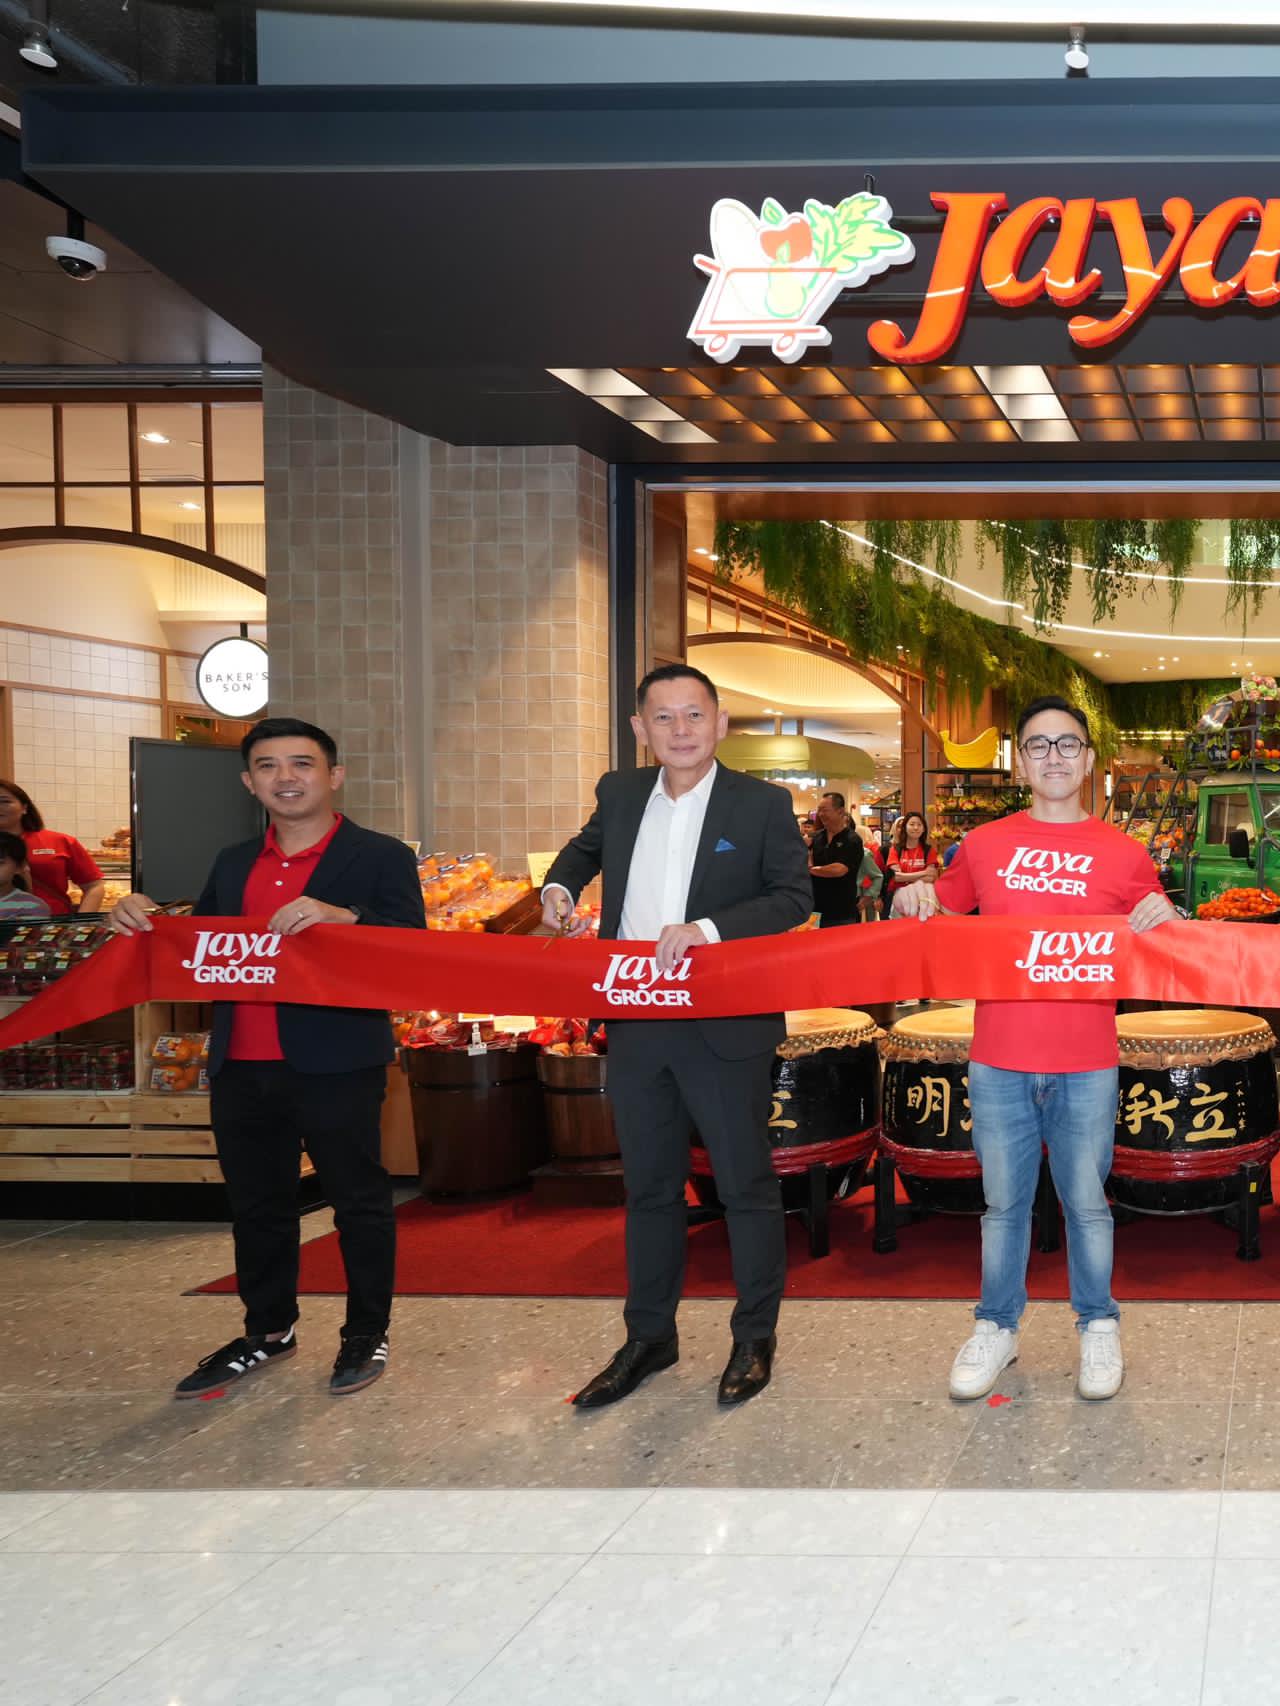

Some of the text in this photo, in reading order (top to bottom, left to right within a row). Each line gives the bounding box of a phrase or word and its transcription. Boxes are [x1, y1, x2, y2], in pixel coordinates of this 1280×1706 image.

[205, 672, 269, 683] BAKER'S
[223, 683, 252, 693] SON
[997, 847, 1094, 877] Jaya
[1005, 874, 1087, 897] GROCER
[181, 931, 282, 969] Jaya
[1014, 930, 1116, 969] Jaya
[194, 965, 277, 984] GROCER
[592, 953, 693, 992] Jaya
[1028, 964, 1115, 983] GROCER
[606, 988, 693, 1007] GROCER
